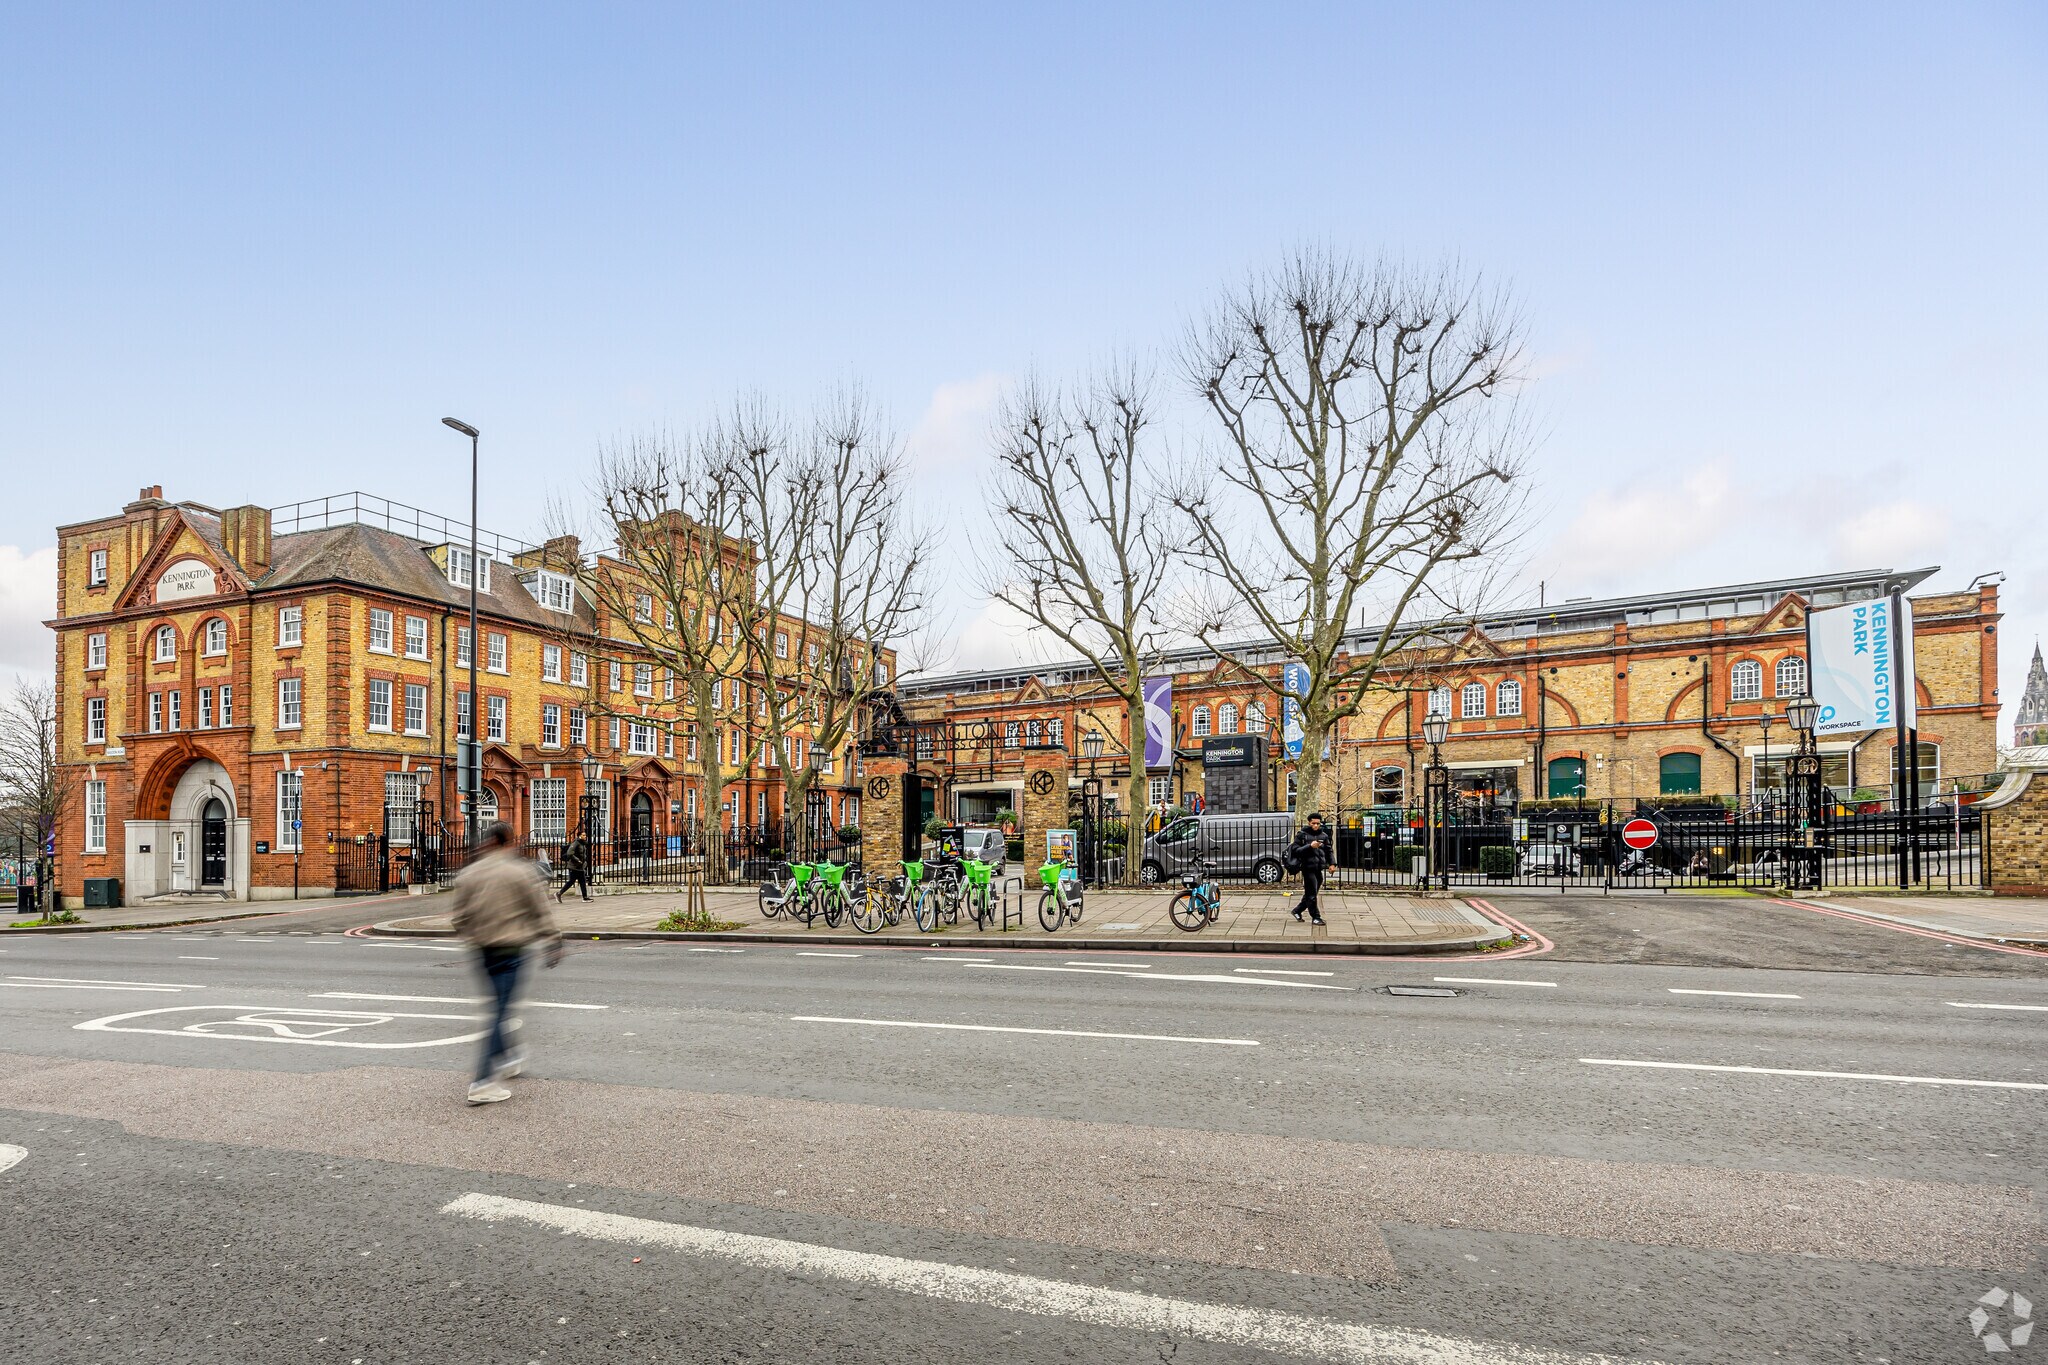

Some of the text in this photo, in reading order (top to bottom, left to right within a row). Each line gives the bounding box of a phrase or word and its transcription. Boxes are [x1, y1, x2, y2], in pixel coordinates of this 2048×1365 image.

[163, 569, 210, 584] KENNINGTON
[177, 581, 195, 591] PARK
[1853, 606, 1868, 655] PARK
[1871, 602, 1890, 724] KENNINGTON
[1289, 668, 1298, 740] WOKSPACE
[1007, 719, 1052, 737] PARK
[1819, 721, 1861, 730] WORKSPACE
[1205, 748, 1243, 756] KENNINGTON
[1206, 755, 1221, 763] PARK
